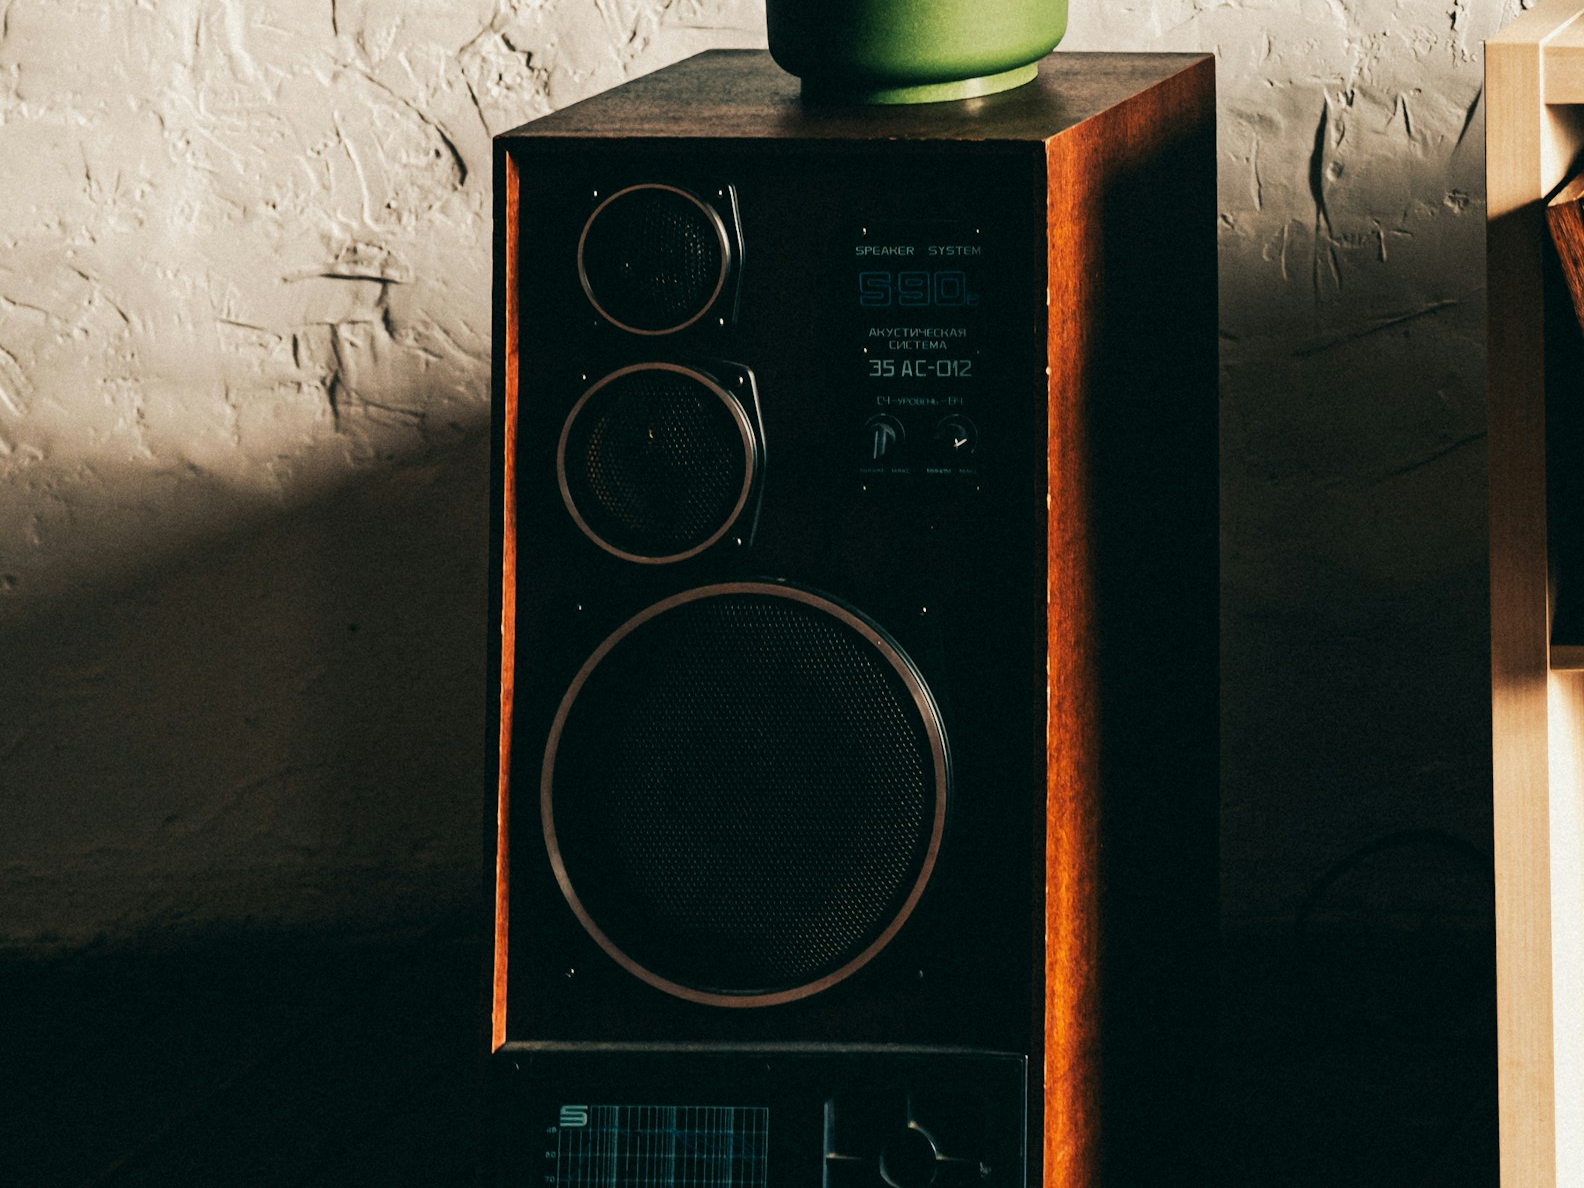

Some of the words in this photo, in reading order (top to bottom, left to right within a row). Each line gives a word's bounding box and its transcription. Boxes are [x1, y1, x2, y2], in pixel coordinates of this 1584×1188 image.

[855, 245, 915, 256] SPEAKER
[928, 245, 982, 256] SYSTEM
[868, 327, 967, 338] АКУСТИЧЕСКАЯ
[888, 339, 948, 350] СИСТЕМА
[868, 359, 896, 377] 35
